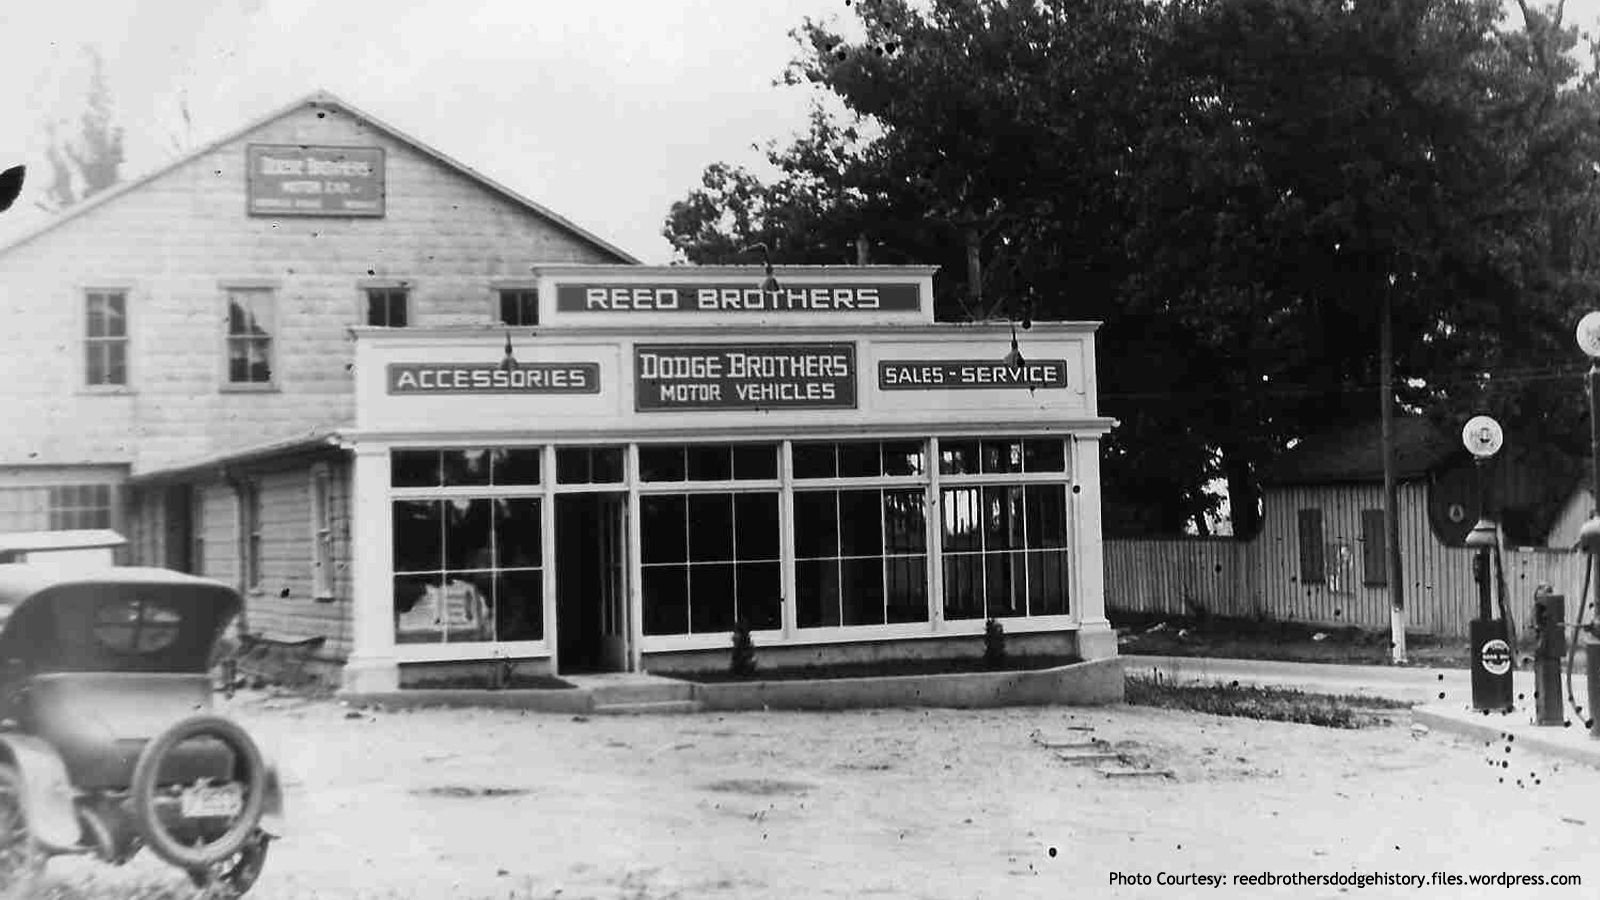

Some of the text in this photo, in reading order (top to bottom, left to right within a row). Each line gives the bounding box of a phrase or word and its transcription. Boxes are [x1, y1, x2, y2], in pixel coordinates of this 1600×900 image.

[586, 288, 880, 309] REED BROTHERS
[640, 352, 848, 379] DODGE BROTHERS
[885, 367, 944, 383] SALES
[961, 366, 1057, 383] SERVICE
[398, 369, 585, 388] ACCESSORIES
[660, 382, 836, 401] MOTOR VEHICLES
